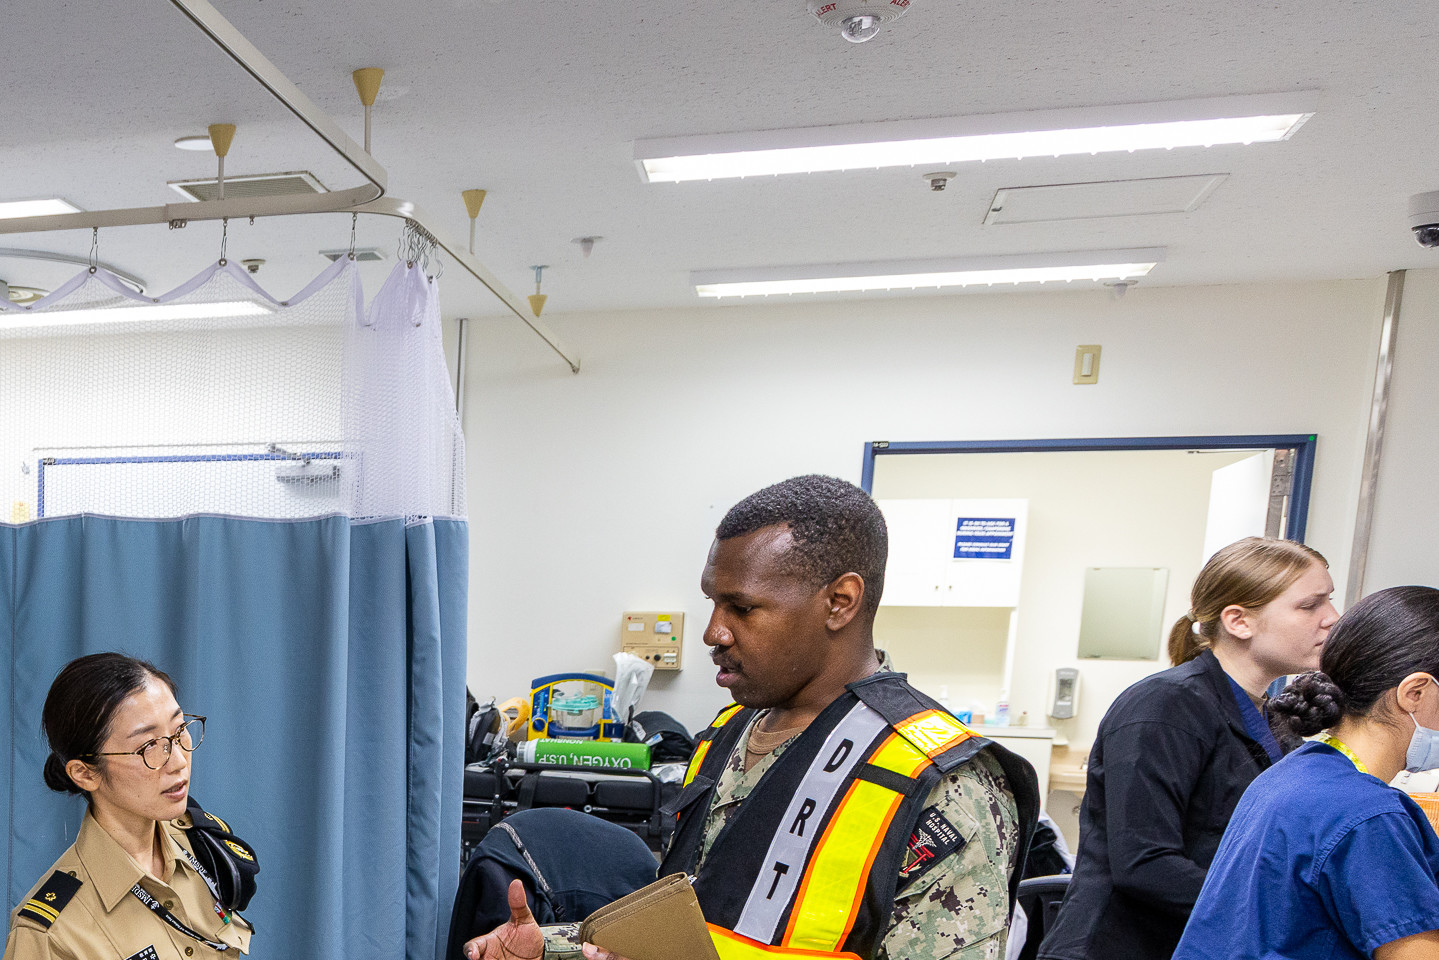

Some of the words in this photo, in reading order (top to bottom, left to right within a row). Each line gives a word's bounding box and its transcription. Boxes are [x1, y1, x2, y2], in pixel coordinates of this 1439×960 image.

[925, 819, 950, 845] HOSPITAL
[929, 812, 940, 825] U.S.
[940, 823, 958, 842] NAVAL
